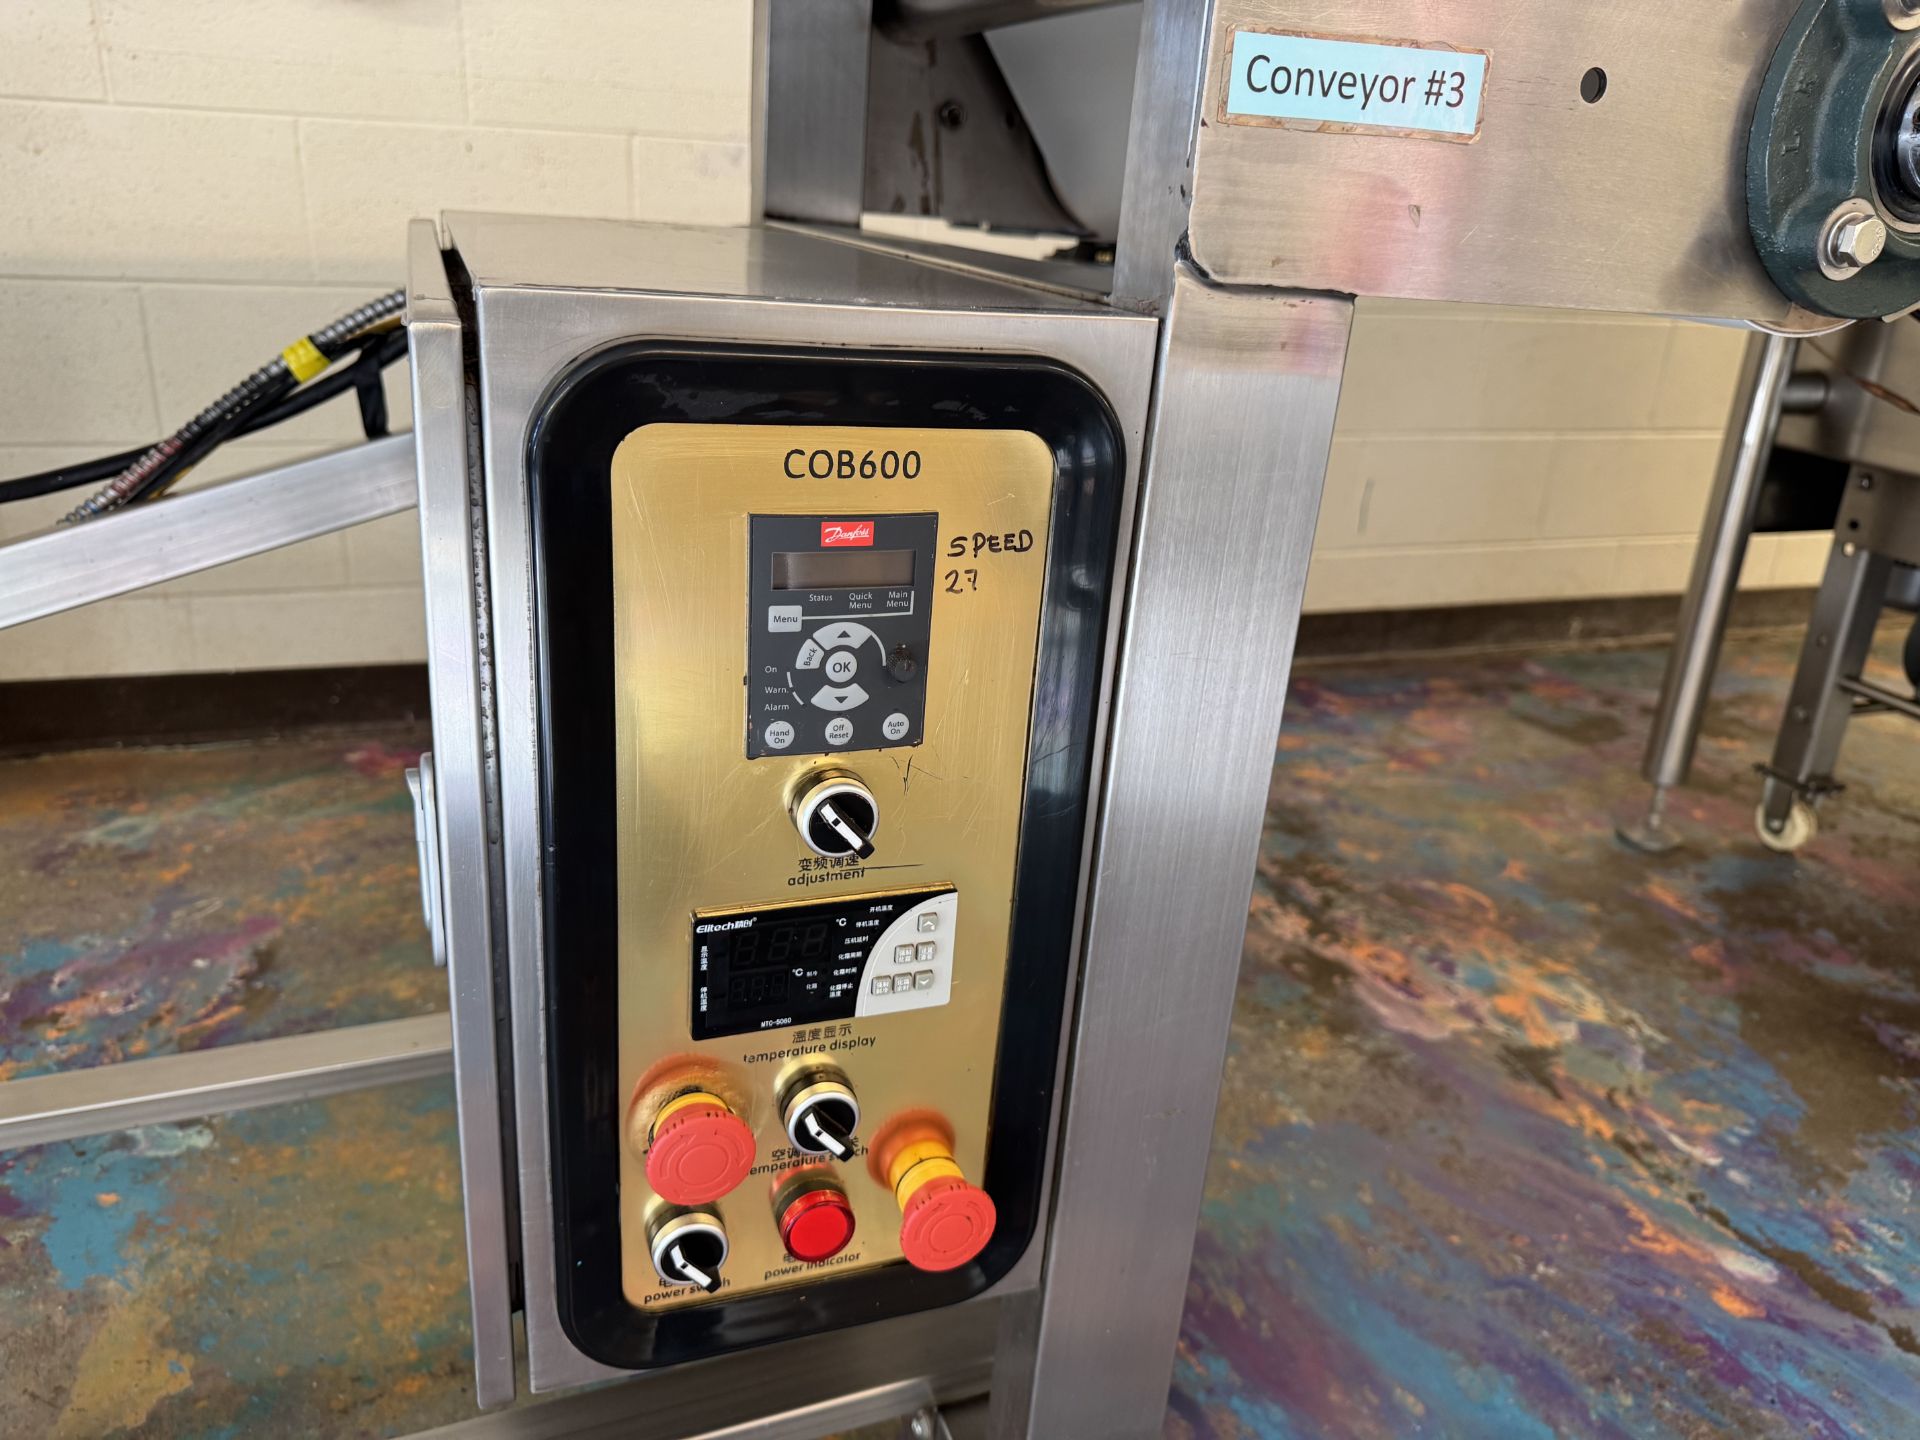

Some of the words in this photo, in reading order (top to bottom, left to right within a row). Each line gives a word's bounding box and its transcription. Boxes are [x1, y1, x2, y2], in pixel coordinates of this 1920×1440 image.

[1246, 54, 1416, 110] Conveyor
[1424, 69, 1466, 108] #3
[783, 449, 922, 479] COB600
[824, 523, 870, 543] Danfoss
[947, 529, 1034, 558] SPEED
[944, 569, 978, 595] 27
[809, 594, 833, 602] Status
[849, 592, 873, 601] Quick
[888, 591, 908, 599] Main
[849, 601, 872, 609] Menu
[886, 600, 909, 608] Menu
[773, 615, 798, 623] Menu
[803, 647, 817, 666] Back
[764, 665, 777, 673] On
[832, 661, 851, 673] OK
[764, 686, 789, 694] Warn.
[832, 724, 845, 732] Off
[887, 720, 905, 728] Auto
[769, 729, 790, 737] Hand
[829, 731, 849, 739] Reset
[890, 727, 901, 735] On
[787, 867, 866, 887] adjustment
[792, 1023, 852, 1043] 温度显示
[743, 1043, 826, 1063] temperature
[829, 1036, 876, 1051] display
[746, 1155, 825, 1176] emperature
[764, 1263, 804, 1280] power
[644, 1287, 686, 1304] power
